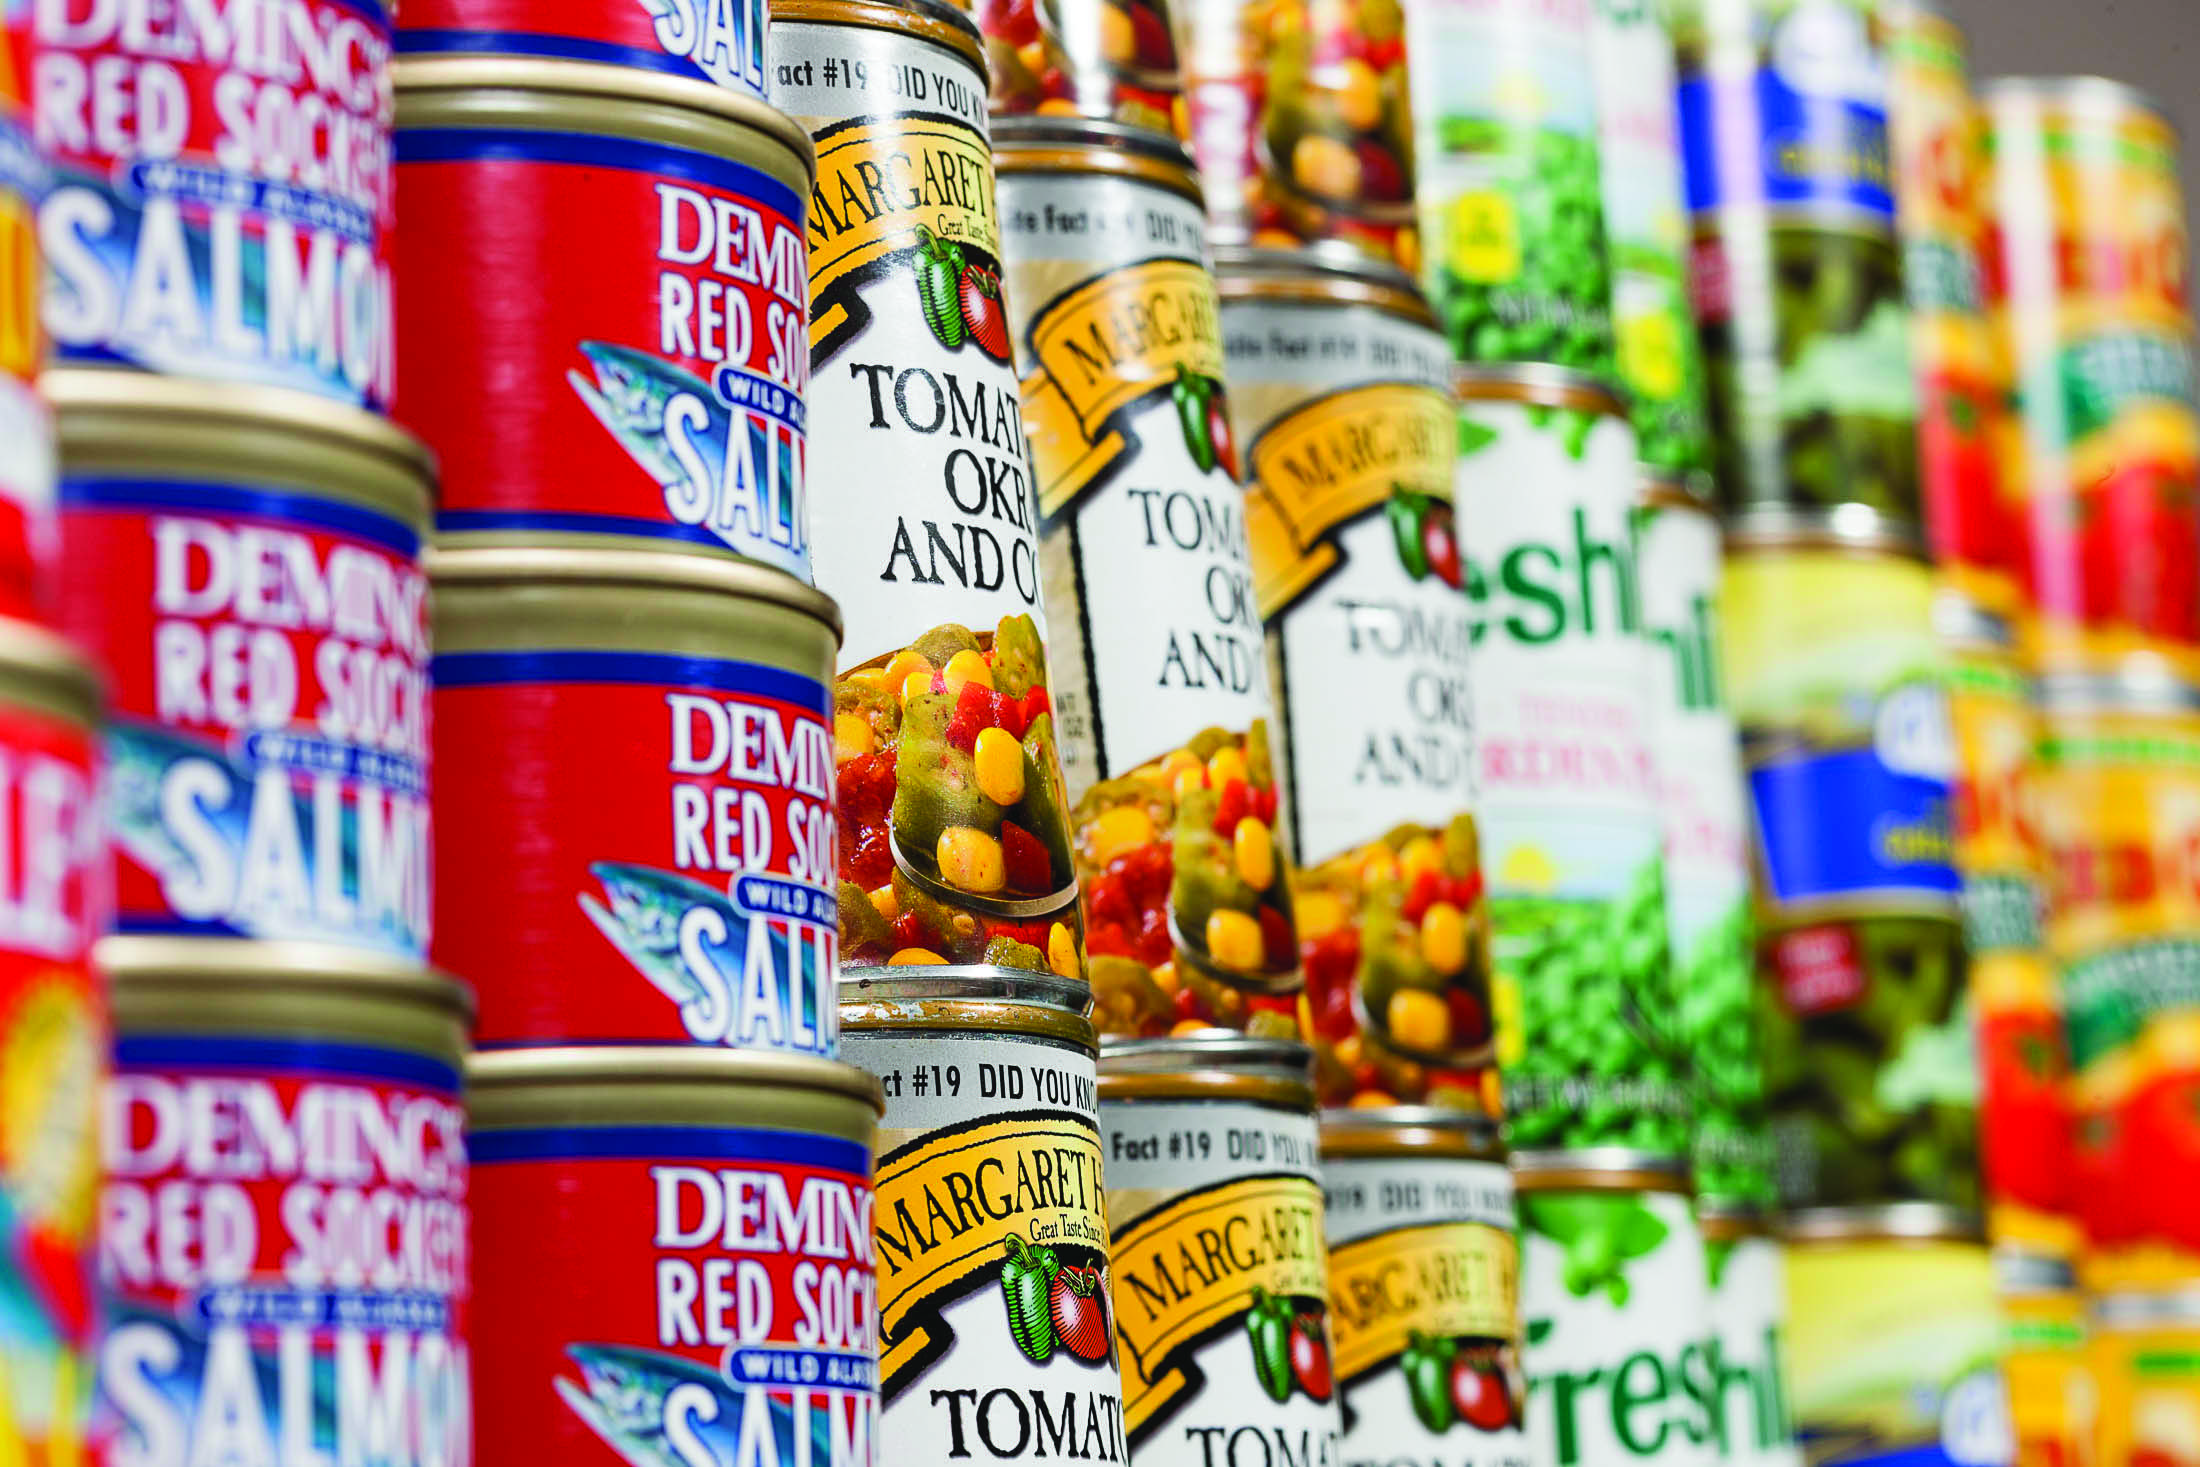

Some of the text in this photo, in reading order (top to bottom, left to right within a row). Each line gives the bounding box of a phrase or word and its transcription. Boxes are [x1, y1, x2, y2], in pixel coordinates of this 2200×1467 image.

[33, 53, 190, 157] RED
[775, 60, 813, 86] act
[932, 72, 968, 118] YOU
[661, 272, 752, 368] RED
[728, 372, 785, 416] WILD
[880, 515, 1004, 592] AND
[155, 621, 297, 728] RED
[1158, 630, 1250, 694] AND
[672, 783, 772, 874] RED
[744, 881, 808, 918] WILD
[913, 1065, 961, 1097] #19
[979, 1063, 1024, 1100] DID
[1031, 1067, 1071, 1107] YOU
[1112, 1132, 1158, 1162] Fact
[1169, 1131, 1211, 1161] #19
[1227, 1129, 1266, 1162] DID
[104, 1182, 258, 1290] RED
[877, 1147, 1087, 1278] MARGARET
[1029, 1218, 1058, 1242] Great
[1060, 1213, 1082, 1238] Taste
[657, 1258, 772, 1347] RED
[740, 1352, 820, 1383] WILD
